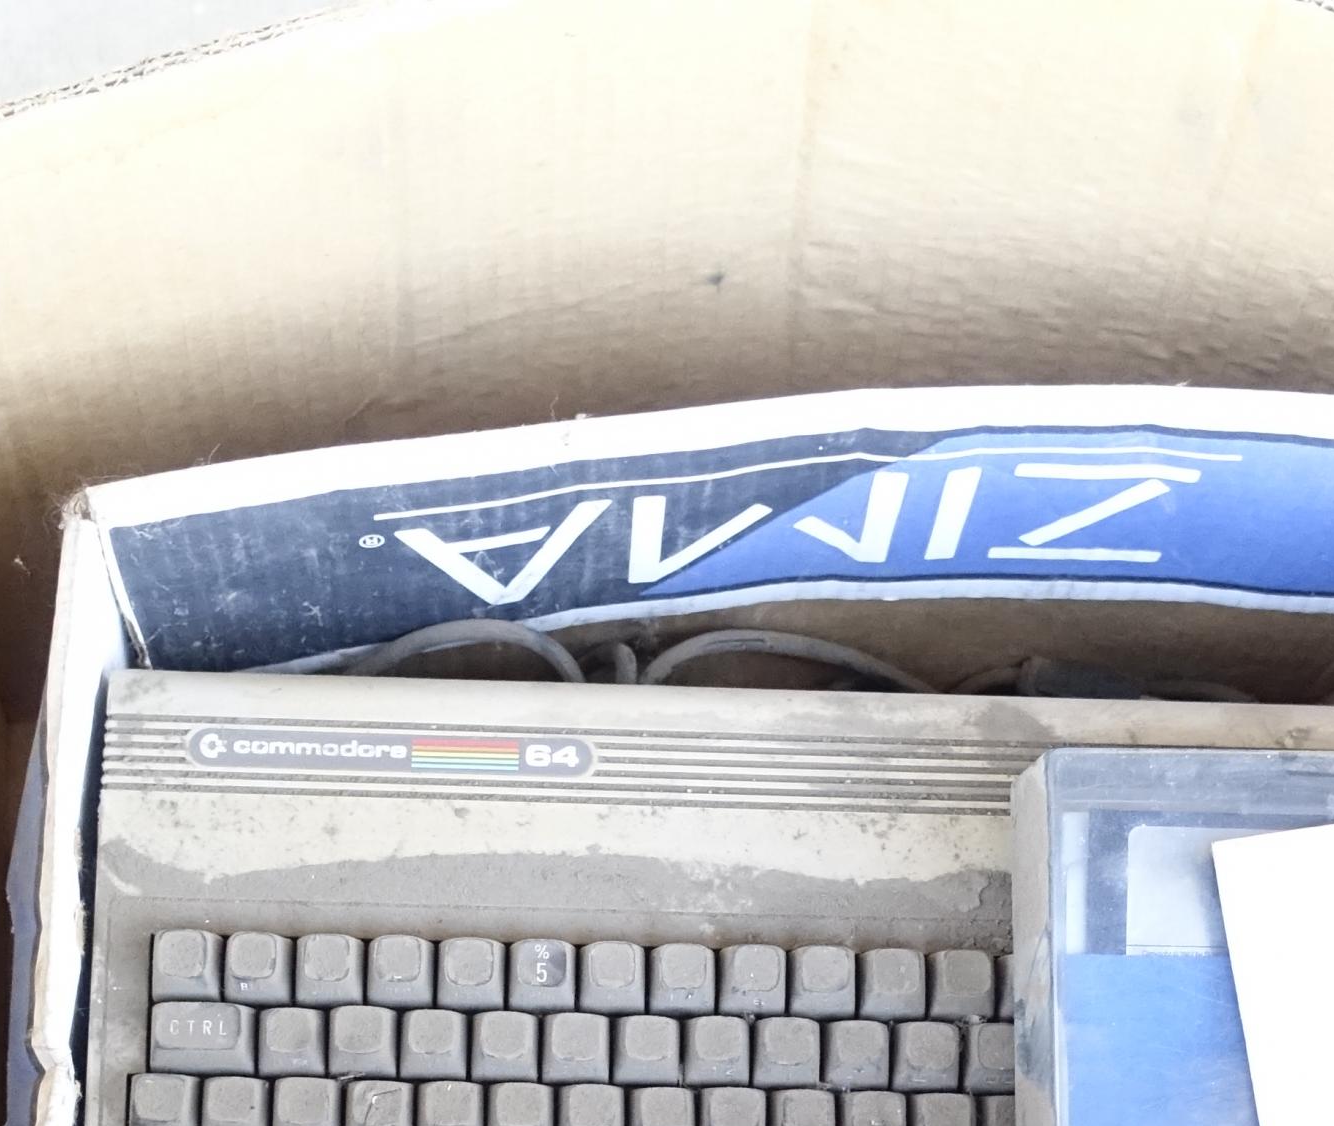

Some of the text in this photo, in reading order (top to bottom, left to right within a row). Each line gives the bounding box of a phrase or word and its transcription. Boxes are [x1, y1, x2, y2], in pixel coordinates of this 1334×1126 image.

[394, 462, 1202, 605] ZIMA
[233, 738, 580, 767] commodore 64
[535, 962, 547, 983] 5
[170, 1020, 227, 1035] CTRL
